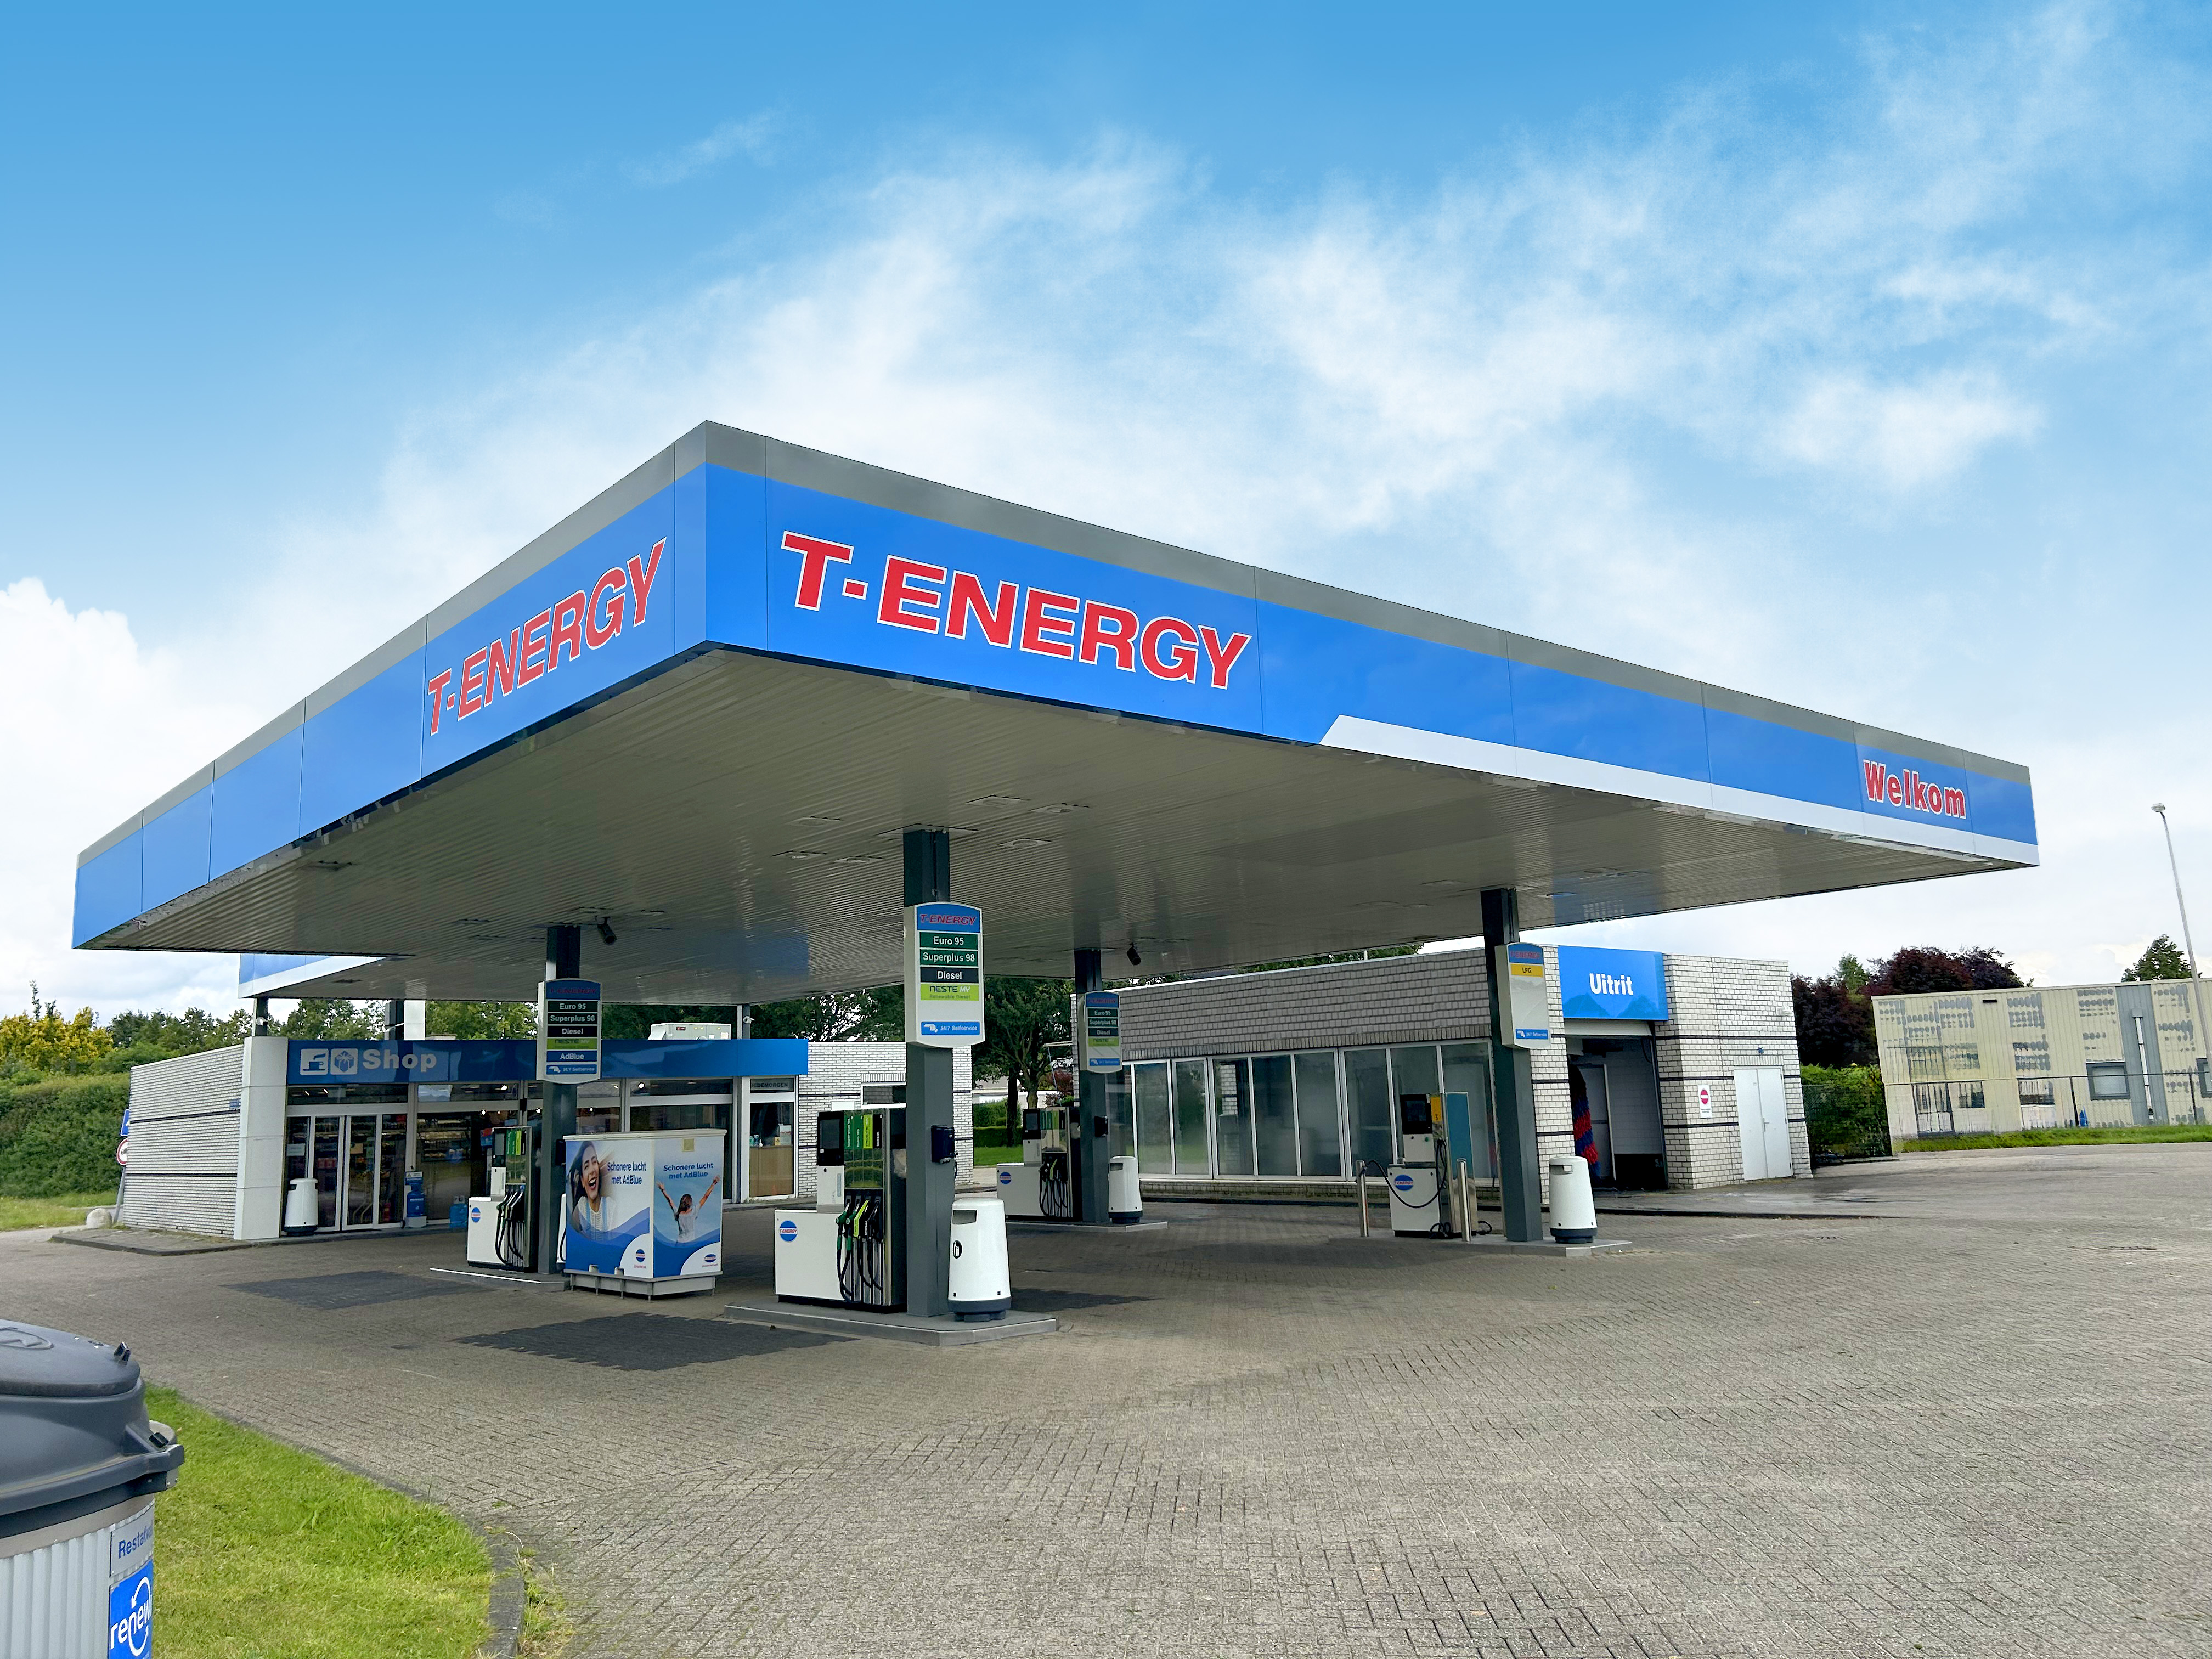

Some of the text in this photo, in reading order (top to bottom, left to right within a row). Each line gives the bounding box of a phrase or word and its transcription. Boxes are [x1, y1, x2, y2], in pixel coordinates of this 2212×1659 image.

[781, 531, 1252, 690] T-ENERGY
[428, 536, 667, 736] T-ENERGY
[1863, 759, 1966, 819] Welkom
[919, 914, 977, 926] T-ENERGY
[933, 936, 964, 945] Euro 95
[923, 952, 975, 963] Superplus 98
[938, 971, 962, 980] Diesel
[1589, 972, 1633, 996] Uitrit
[362, 1049, 437, 1073] Shop
[607, 1161, 646, 1171] Schonere lucht
[611, 1175, 642, 1184] met AdBlue
